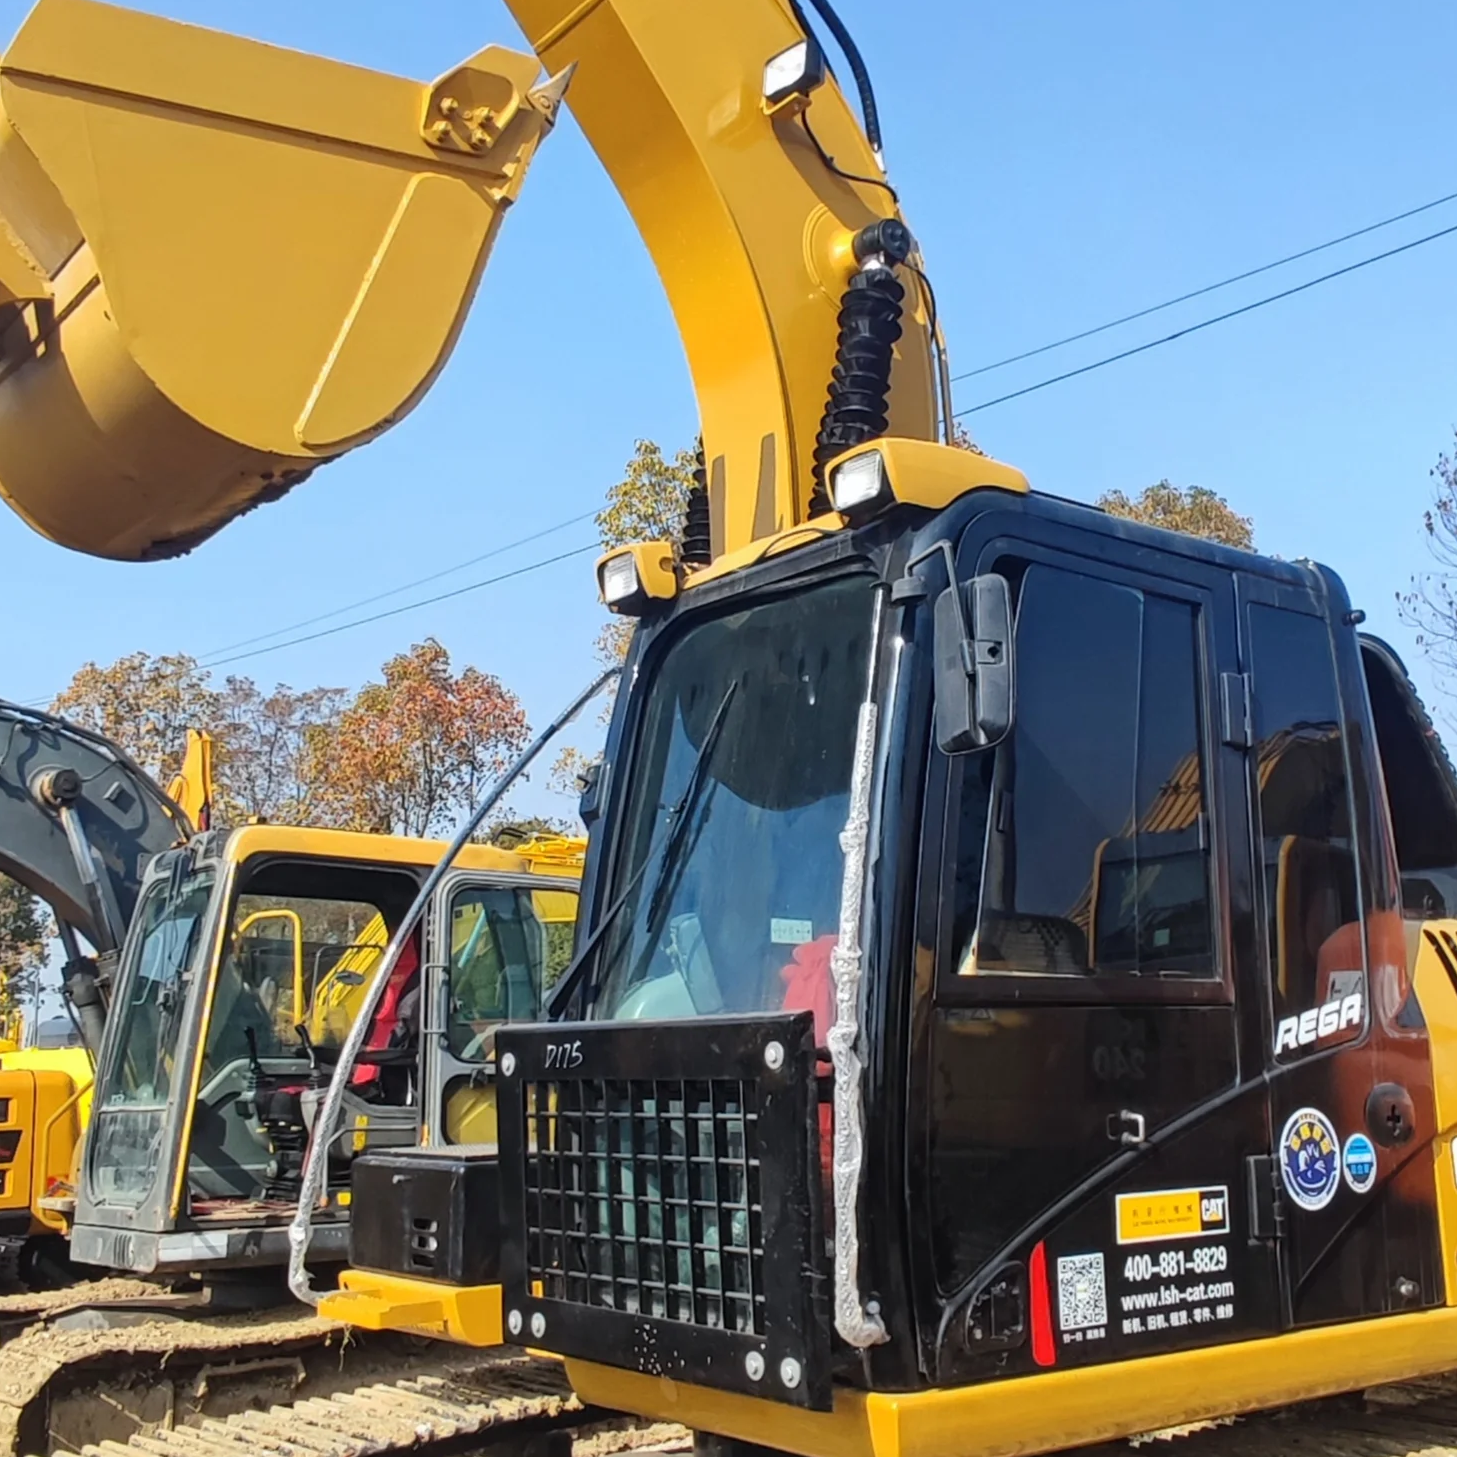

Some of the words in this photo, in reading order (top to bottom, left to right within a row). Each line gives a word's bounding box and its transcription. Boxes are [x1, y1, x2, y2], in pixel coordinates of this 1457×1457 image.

[1274, 993, 1362, 1056] REGA
[1201, 1197, 1225, 1221] CAT
[1124, 1245, 1228, 1282] 400-881-8829
[1120, 1282, 1234, 1312] www.lsh-cat.com
